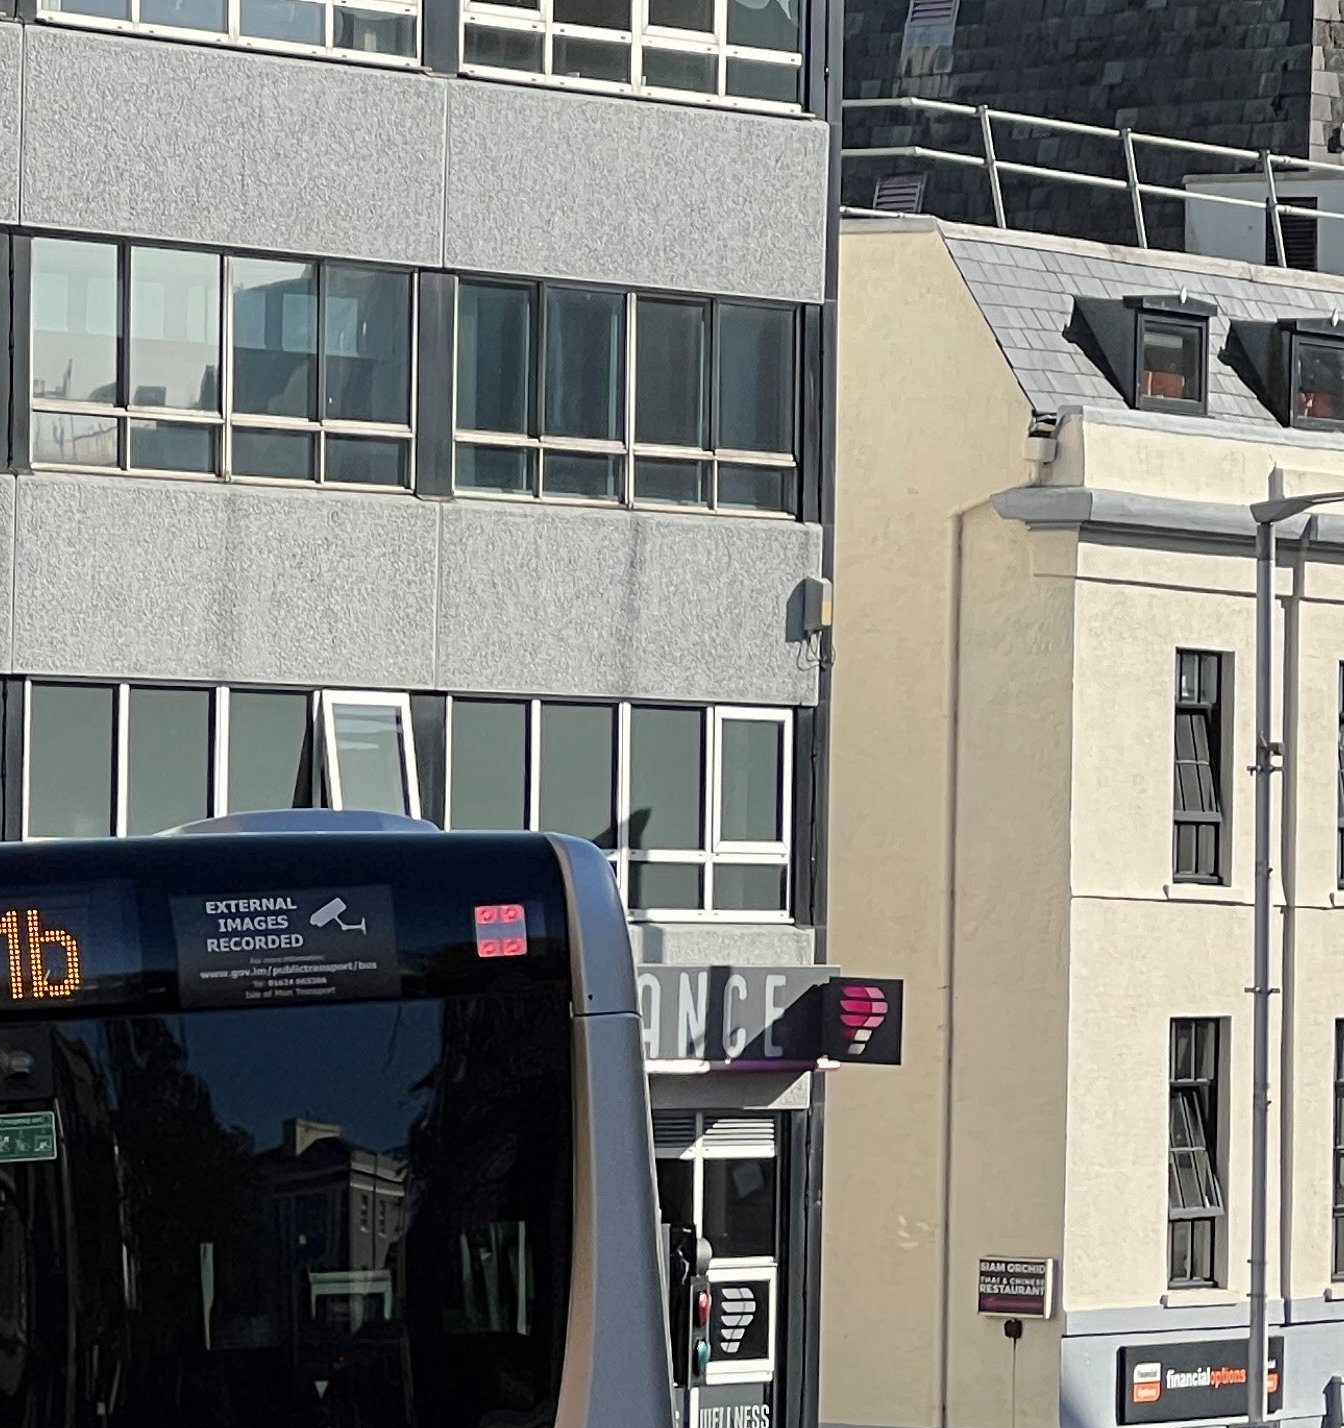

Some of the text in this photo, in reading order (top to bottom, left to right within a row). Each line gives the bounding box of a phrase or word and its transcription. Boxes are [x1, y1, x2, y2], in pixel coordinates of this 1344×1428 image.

[205, 897, 298, 914] EXTERNAL
[218, 914, 289, 932] IMAGES
[206, 933, 304, 952] RECORDED
[980, 1262, 1046, 1274] SIAM ORCHID
[979, 1284, 1044, 1295] RESTAURANT
[1166, 1366, 1246, 1389] financialoptions
